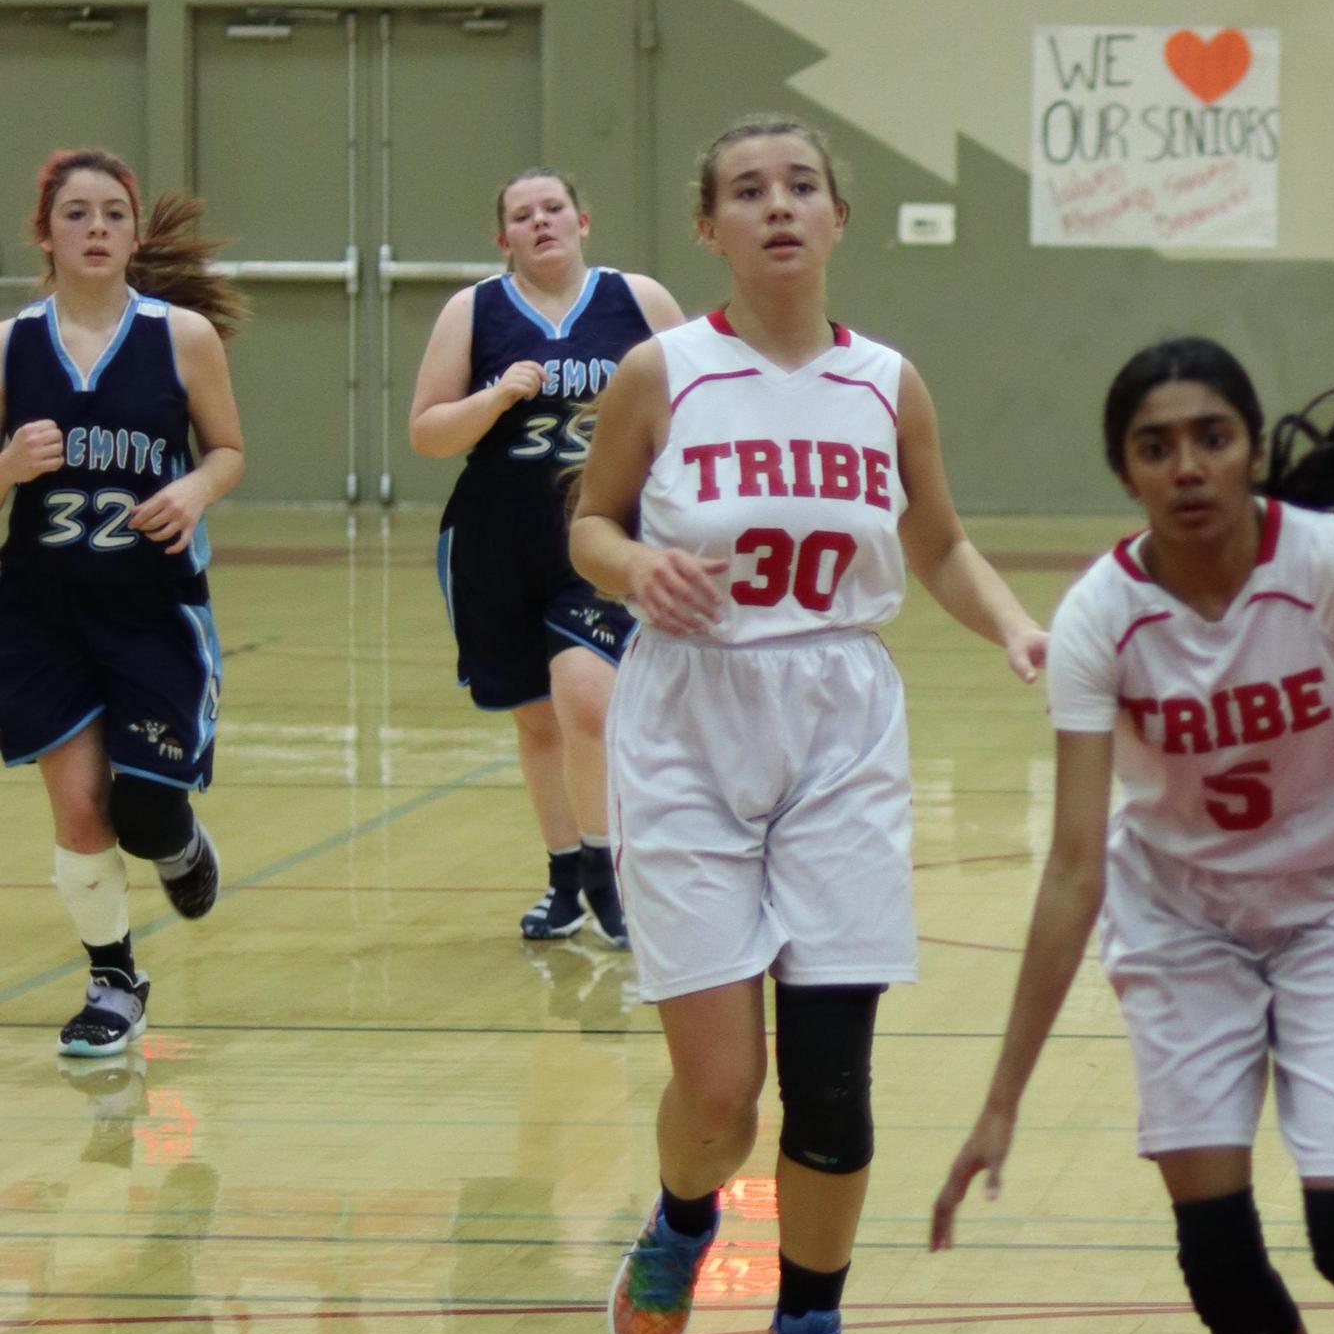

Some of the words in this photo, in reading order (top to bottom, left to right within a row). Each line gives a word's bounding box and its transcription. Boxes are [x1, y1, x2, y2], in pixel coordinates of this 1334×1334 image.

[1048, 33, 1136, 92] WE
[1042, 99, 1130, 165] OUR
[1139, 105, 1279, 163] SENIORS
[66, 425, 167, 475] EMITE
[682, 439, 891, 511] TRIBE
[39, 486, 139, 553] 32
[730, 527, 858, 612] 30
[1118, 667, 1332, 755] TRIBE
[1201, 758, 1273, 831] 5
